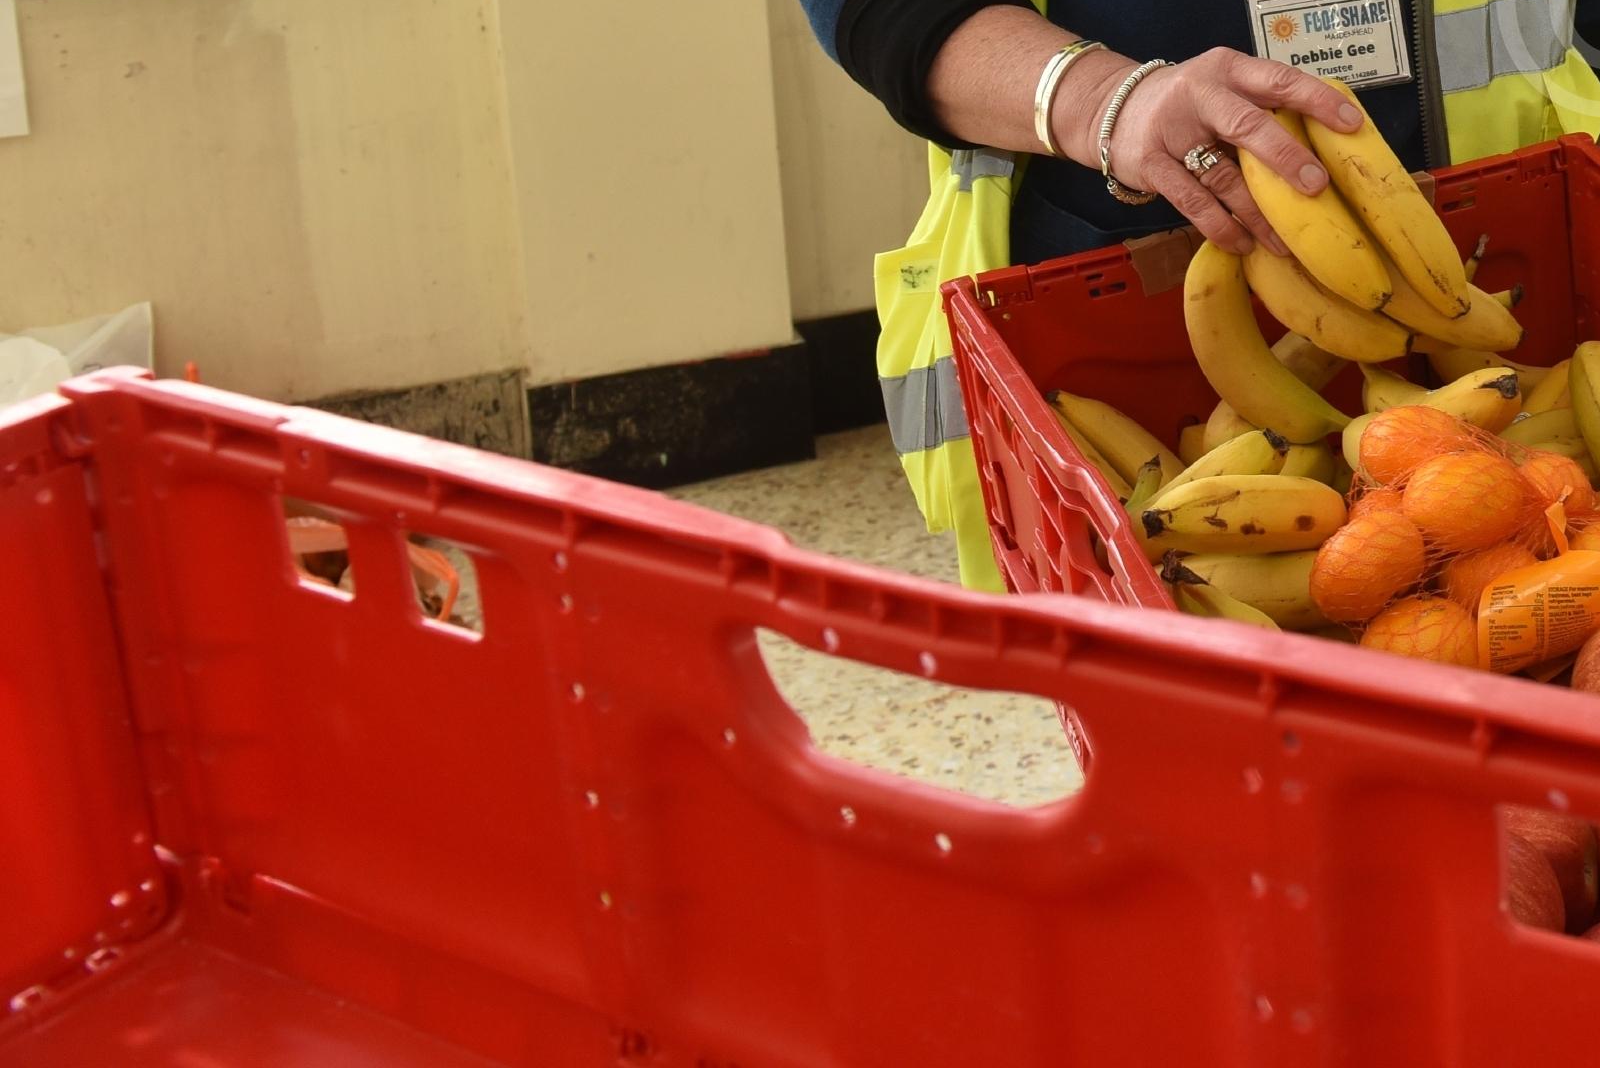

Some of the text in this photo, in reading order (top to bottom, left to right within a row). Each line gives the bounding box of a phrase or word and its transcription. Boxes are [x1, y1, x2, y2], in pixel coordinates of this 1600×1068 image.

[1290, 43, 1376, 66] Debbie Gee
[1316, 62, 1354, 76] Trustee
